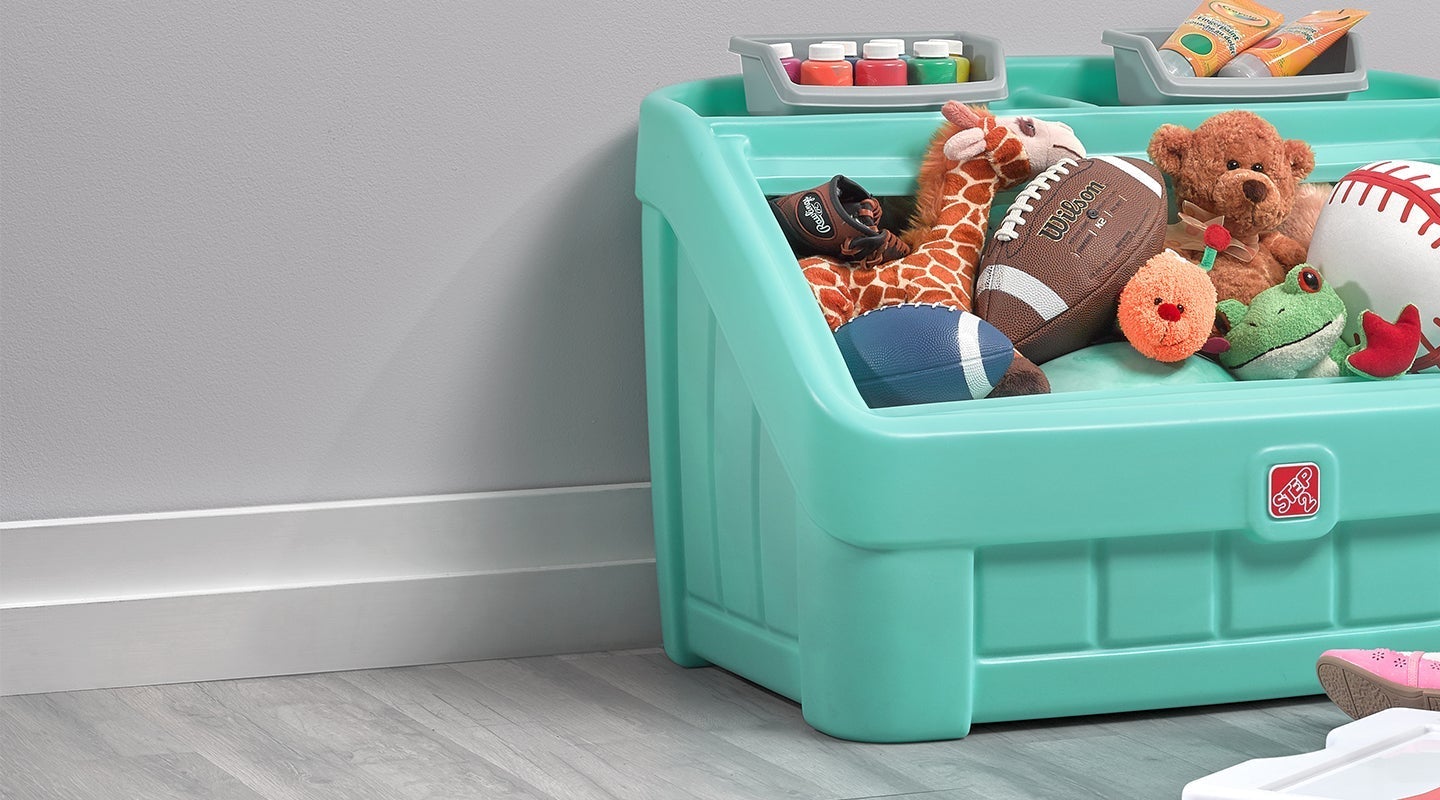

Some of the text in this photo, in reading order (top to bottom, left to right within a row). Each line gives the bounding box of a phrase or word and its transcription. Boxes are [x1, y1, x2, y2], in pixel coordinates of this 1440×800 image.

[802, 196, 831, 233] Rawlings
[1036, 180, 1107, 242] Wilson
[1094, 217, 1107, 229] K2
[1272, 466, 1313, 514] STEP
[1298, 491, 1317, 513] 2
